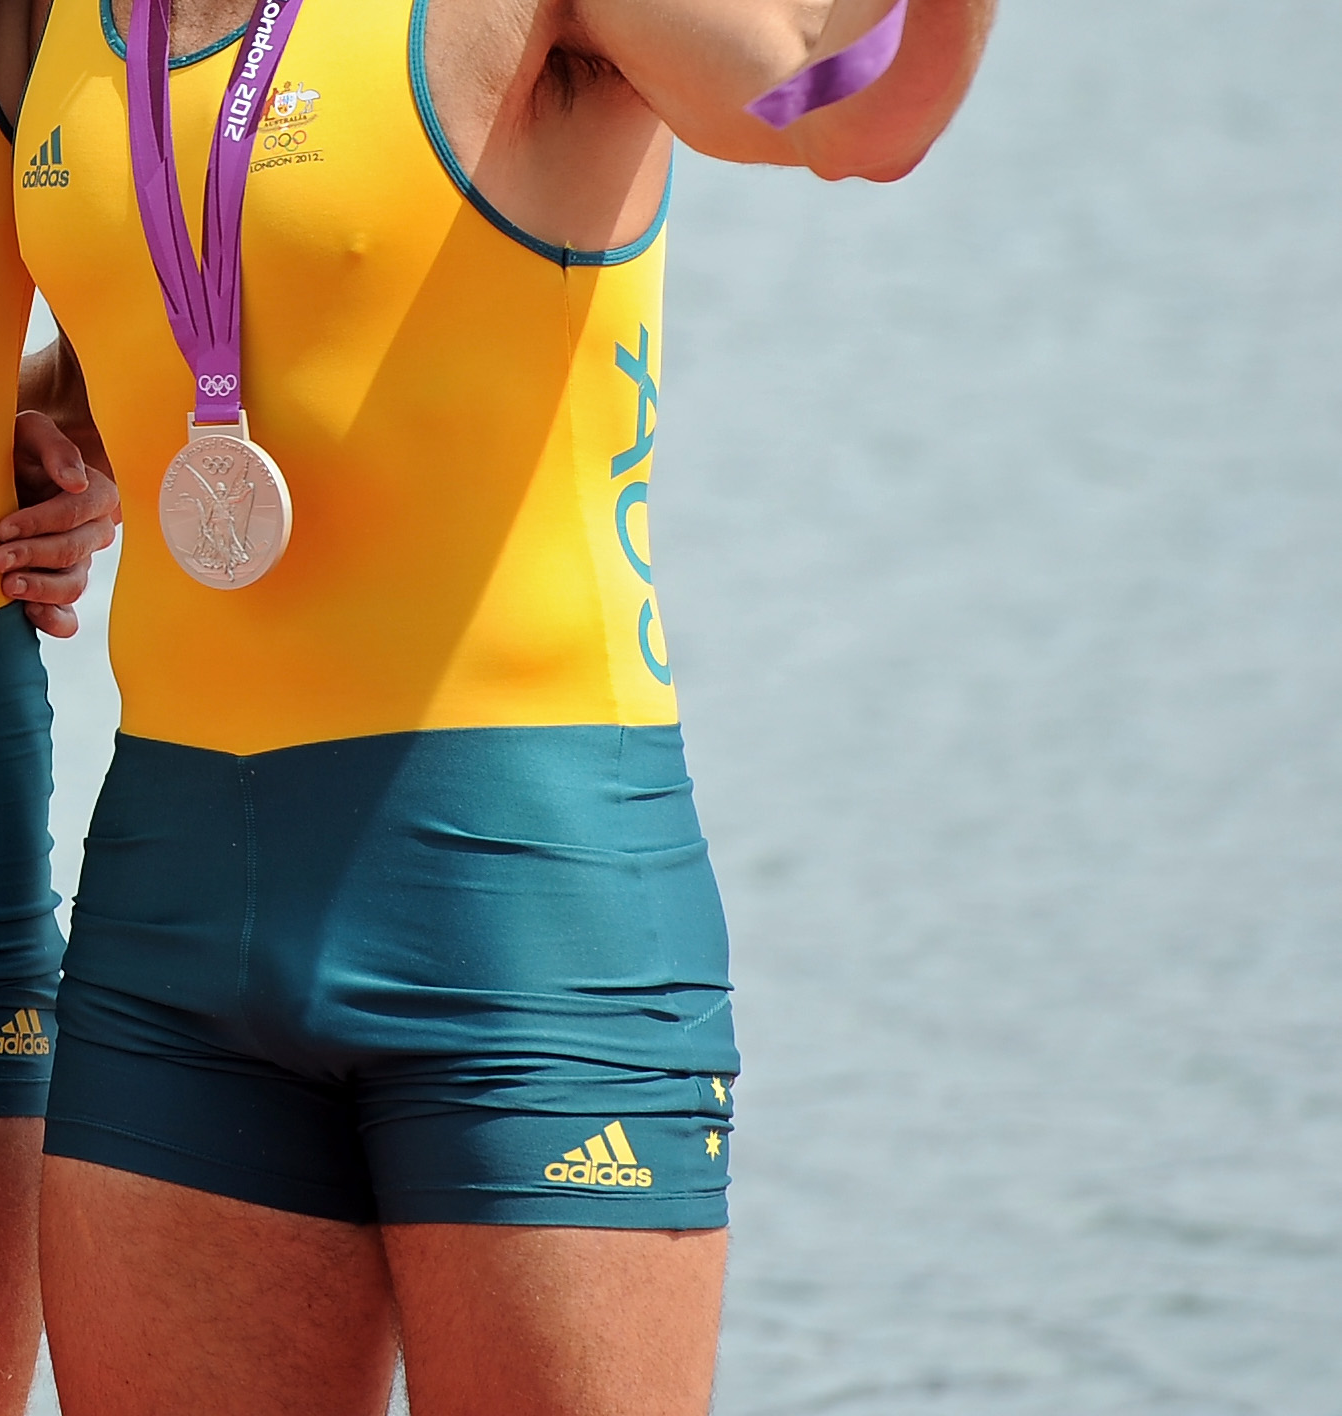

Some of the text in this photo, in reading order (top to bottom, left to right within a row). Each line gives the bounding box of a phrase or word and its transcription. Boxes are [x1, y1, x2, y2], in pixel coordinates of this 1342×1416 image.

[224, 84, 257, 142] 2012
[250, 153, 319, 173] LONDON 2012
[22, 165, 70, 188] adidas
[544, 1160, 653, 1187] adidas
